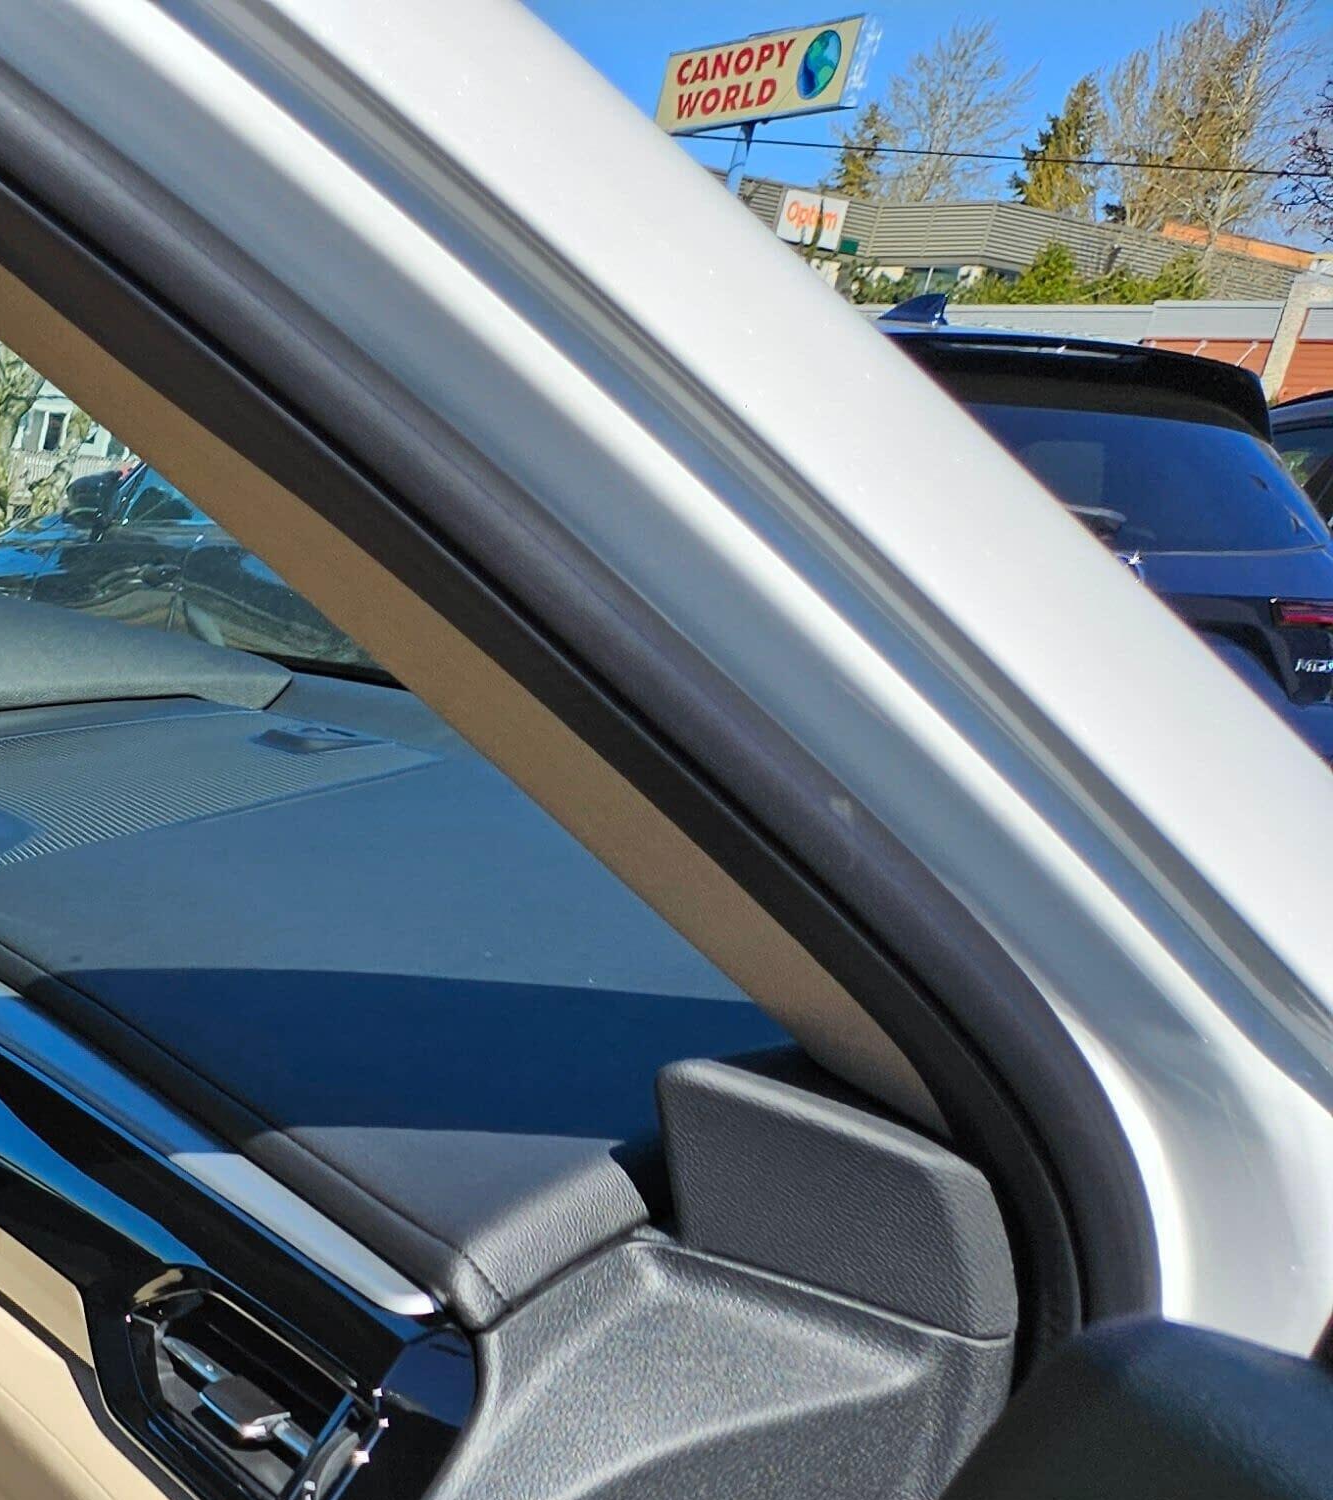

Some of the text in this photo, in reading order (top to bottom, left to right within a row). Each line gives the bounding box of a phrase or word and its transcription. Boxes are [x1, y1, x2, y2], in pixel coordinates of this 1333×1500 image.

[676, 38, 796, 87] CANOPY
[676, 78, 777, 119] WORLD
[786, 200, 837, 231] Optm
[1294, 658, 1333, 673] MD
